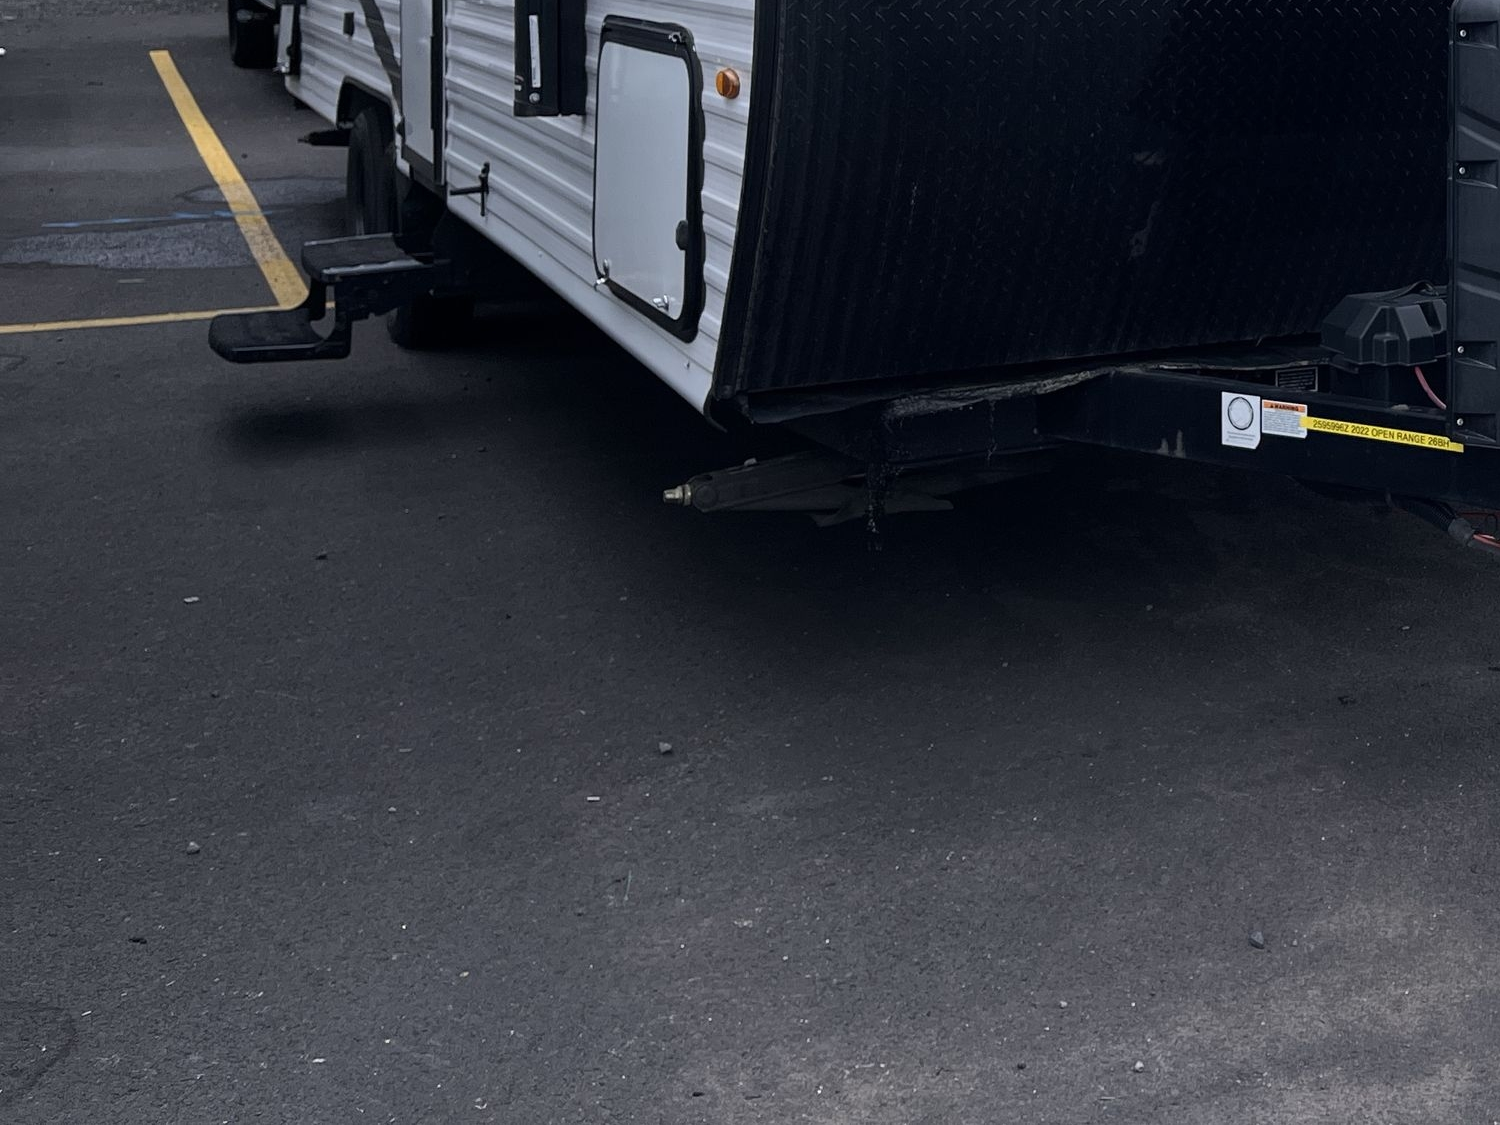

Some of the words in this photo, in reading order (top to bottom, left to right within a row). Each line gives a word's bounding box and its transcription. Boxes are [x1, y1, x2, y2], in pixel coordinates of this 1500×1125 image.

[1351, 425, 1370, 436] 2022
[1371, 428, 1395, 439] OPEN
[1396, 432, 1427, 445] RANGE
[1428, 436, 1450, 448] 26BH
